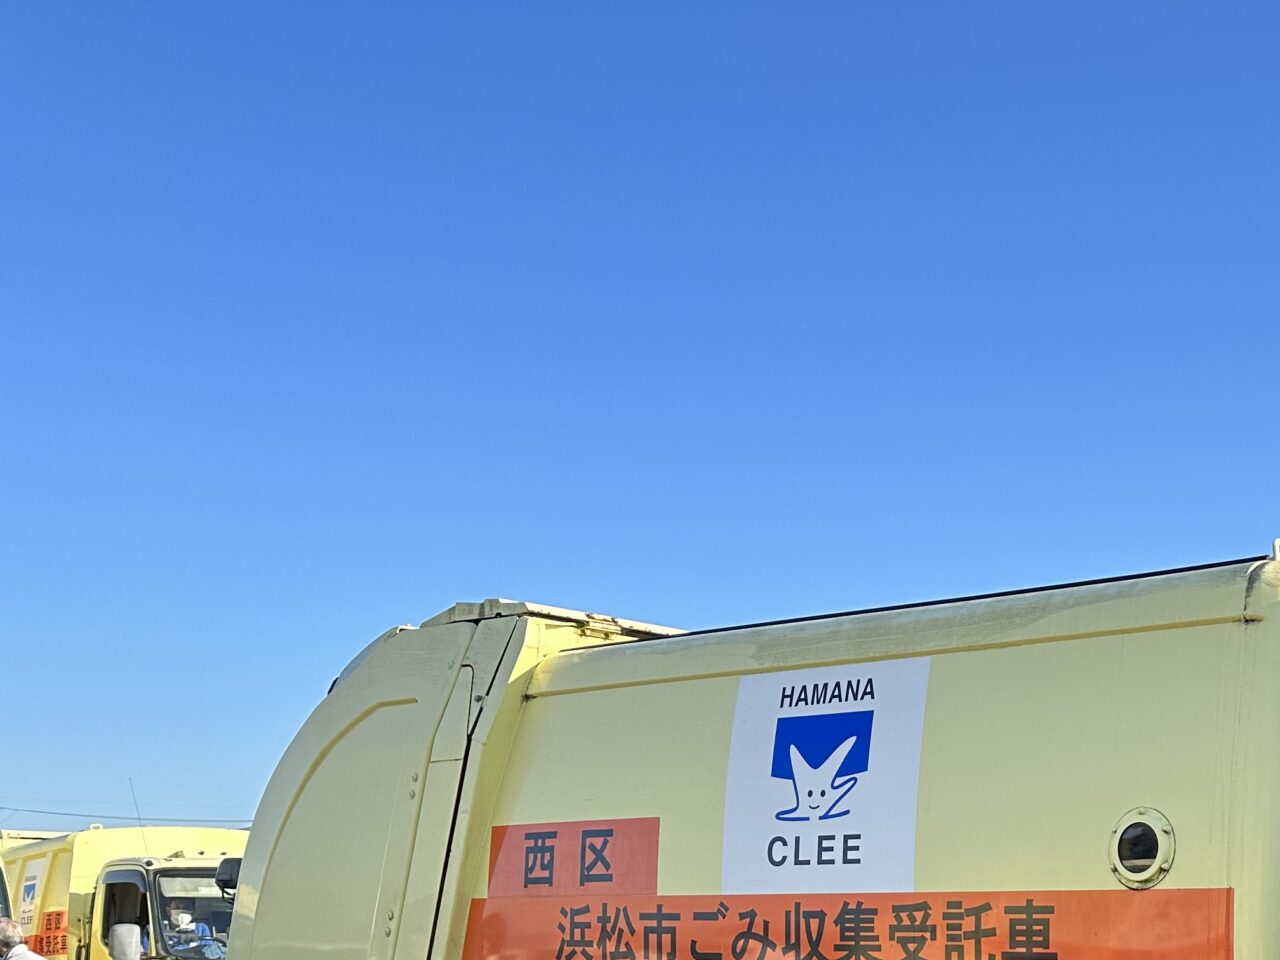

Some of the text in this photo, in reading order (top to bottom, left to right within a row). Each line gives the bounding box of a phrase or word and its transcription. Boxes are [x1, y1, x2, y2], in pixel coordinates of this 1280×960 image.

[779, 677, 876, 709] HAMANA
[523, 828, 615, 888] 西区
[766, 833, 862, 867] CLEE
